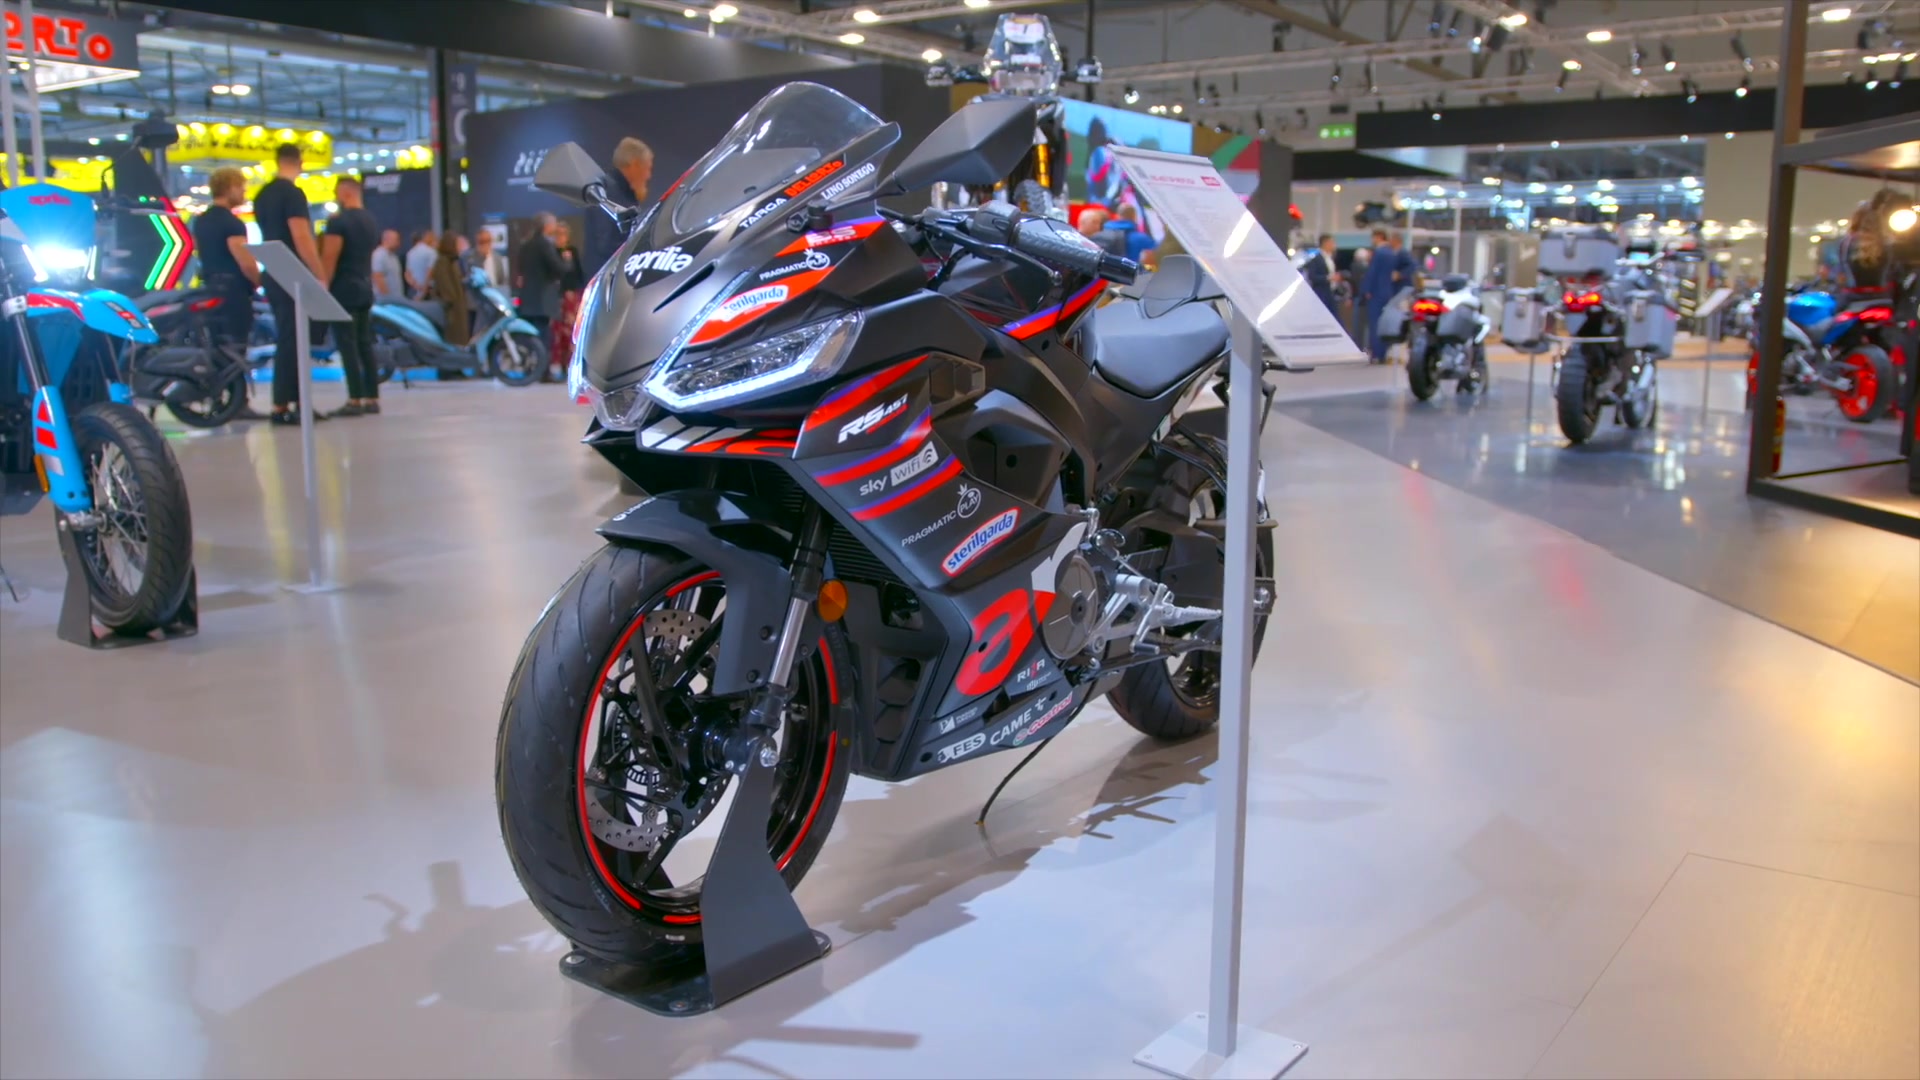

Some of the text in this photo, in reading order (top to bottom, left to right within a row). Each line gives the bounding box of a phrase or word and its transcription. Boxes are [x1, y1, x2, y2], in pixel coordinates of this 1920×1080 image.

[820, 162, 876, 200] LINO SONEGO
[740, 198, 787, 228] TARGA
[624, 246, 694, 276] aprilia
[759, 262, 808, 281] PRAGMATIC
[859, 475, 887, 496] sky
[901, 495, 980, 547] PRAGMATIC PLAY
[948, 514, 1014, 569] sterilgarda
[990, 708, 1032, 745] CAME
[953, 736, 982, 756] FES
